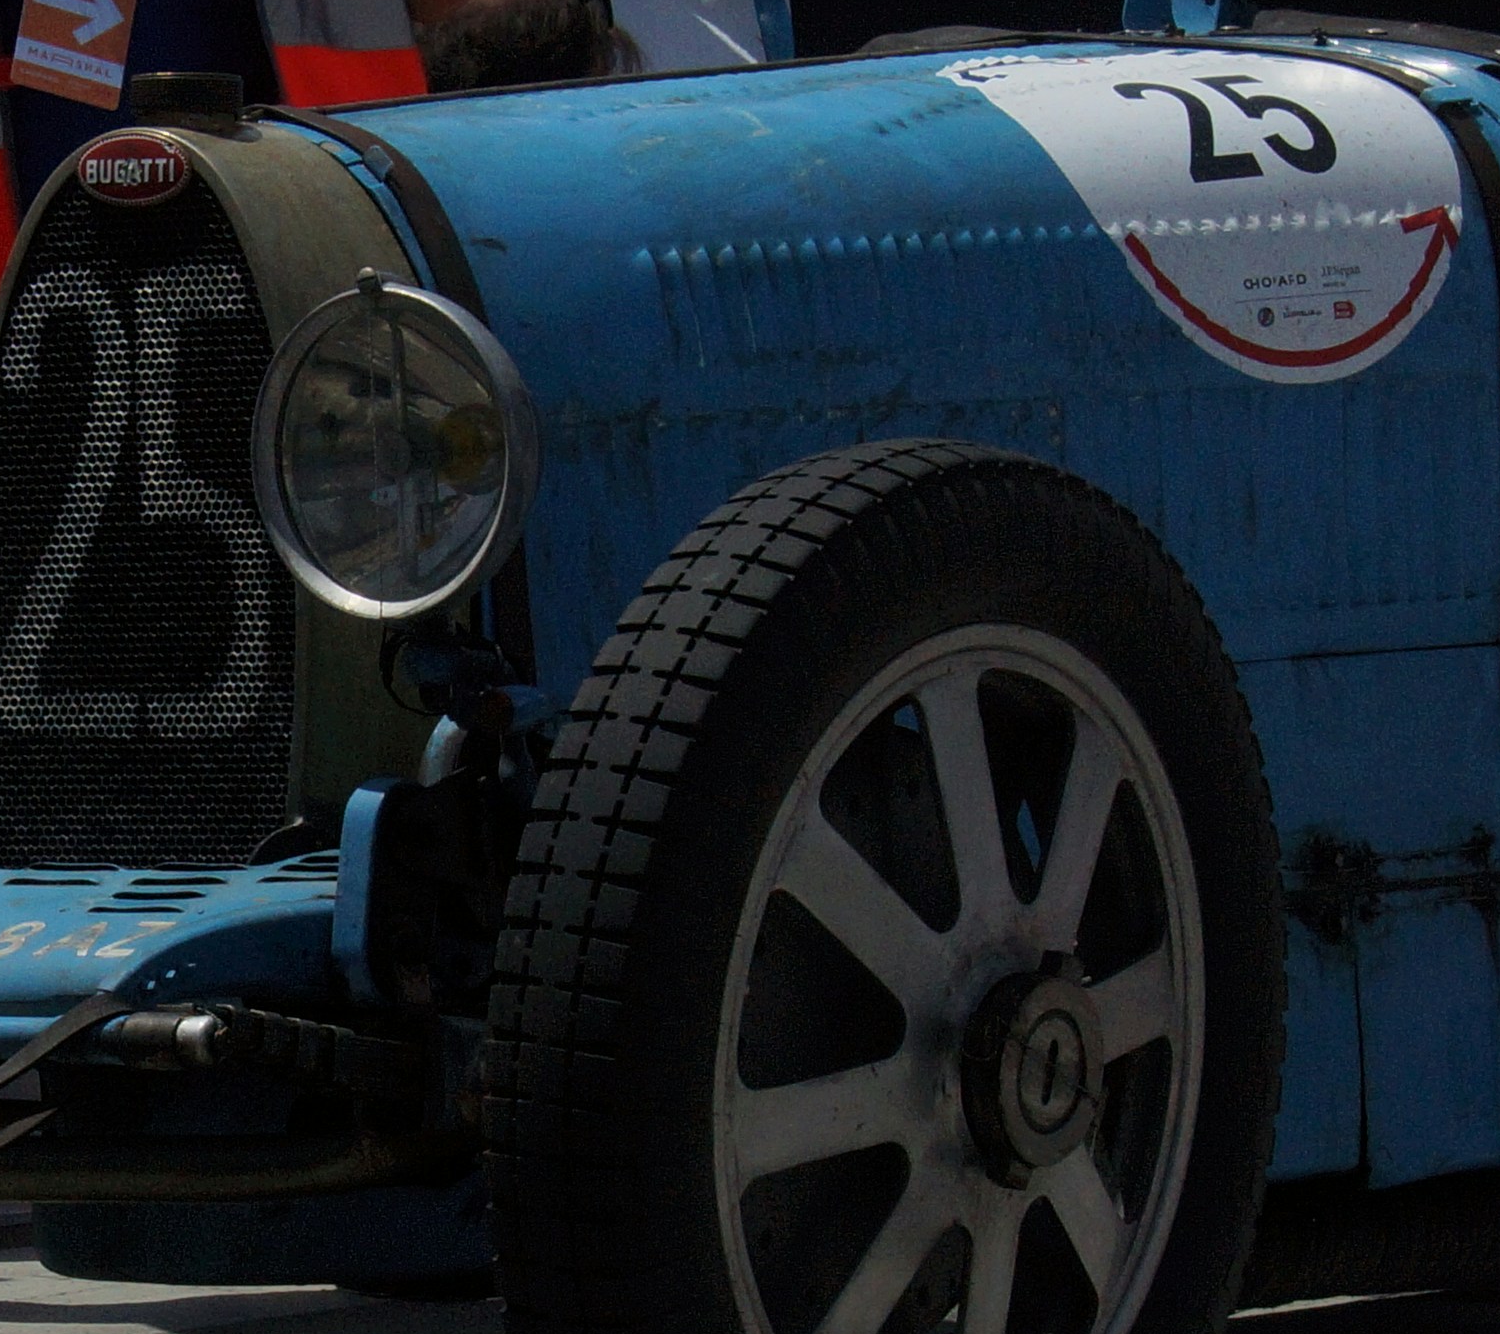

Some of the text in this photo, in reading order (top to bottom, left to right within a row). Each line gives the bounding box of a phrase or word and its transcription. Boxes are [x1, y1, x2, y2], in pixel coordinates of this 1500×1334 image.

[1113, 75, 1337, 183] 25
[85, 157, 176, 187] BUGATTI
[31, 920, 178, 958] AZ
